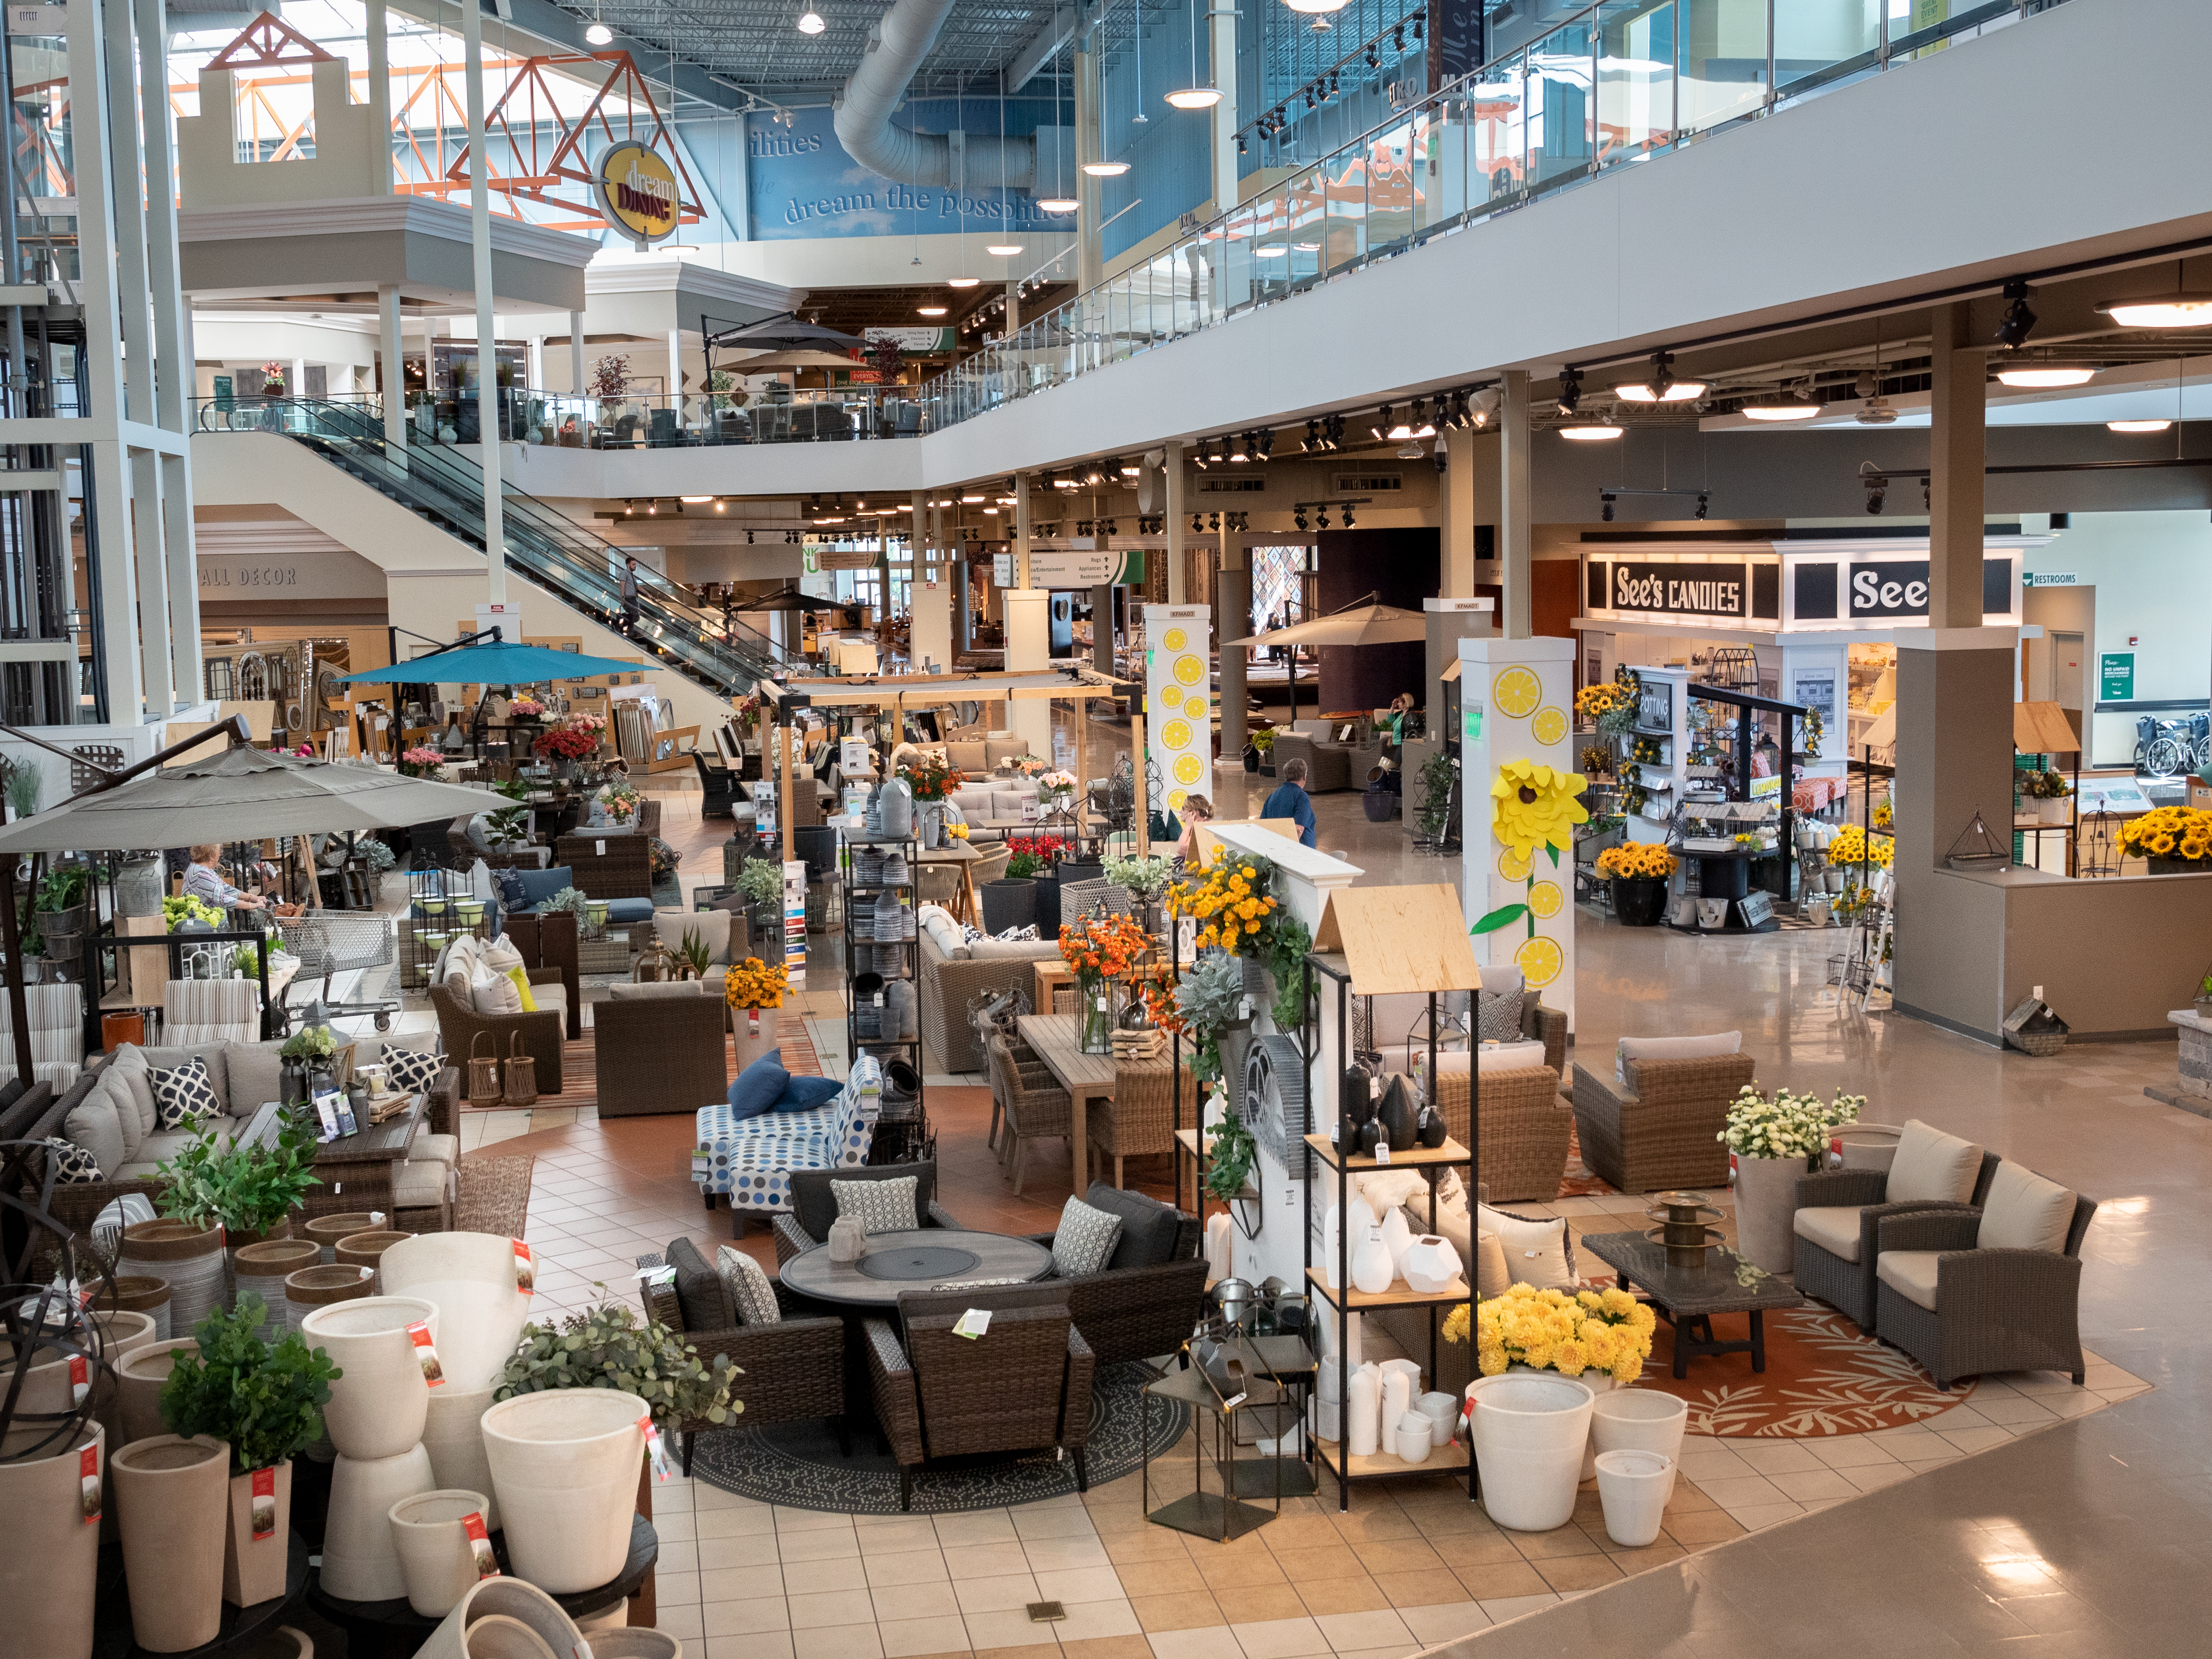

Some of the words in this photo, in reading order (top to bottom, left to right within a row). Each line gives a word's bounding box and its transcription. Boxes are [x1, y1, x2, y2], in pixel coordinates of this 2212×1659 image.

[625, 160, 675, 202] dream
[617, 182, 671, 221] DINING
[784, 192, 877, 225] dream
[887, 183, 930, 211] the
[240, 568, 297, 586] DECOR
[1617, 566, 1662, 608] See's
[1669, 580, 1739, 612] CANDIES
[1853, 570, 1930, 609] See
[2035, 575, 2076, 584] RESTROOMS
[1643, 685, 1654, 695] The
[1640, 696, 1668, 716] POTTING
[1653, 716, 1666, 728] Shed
